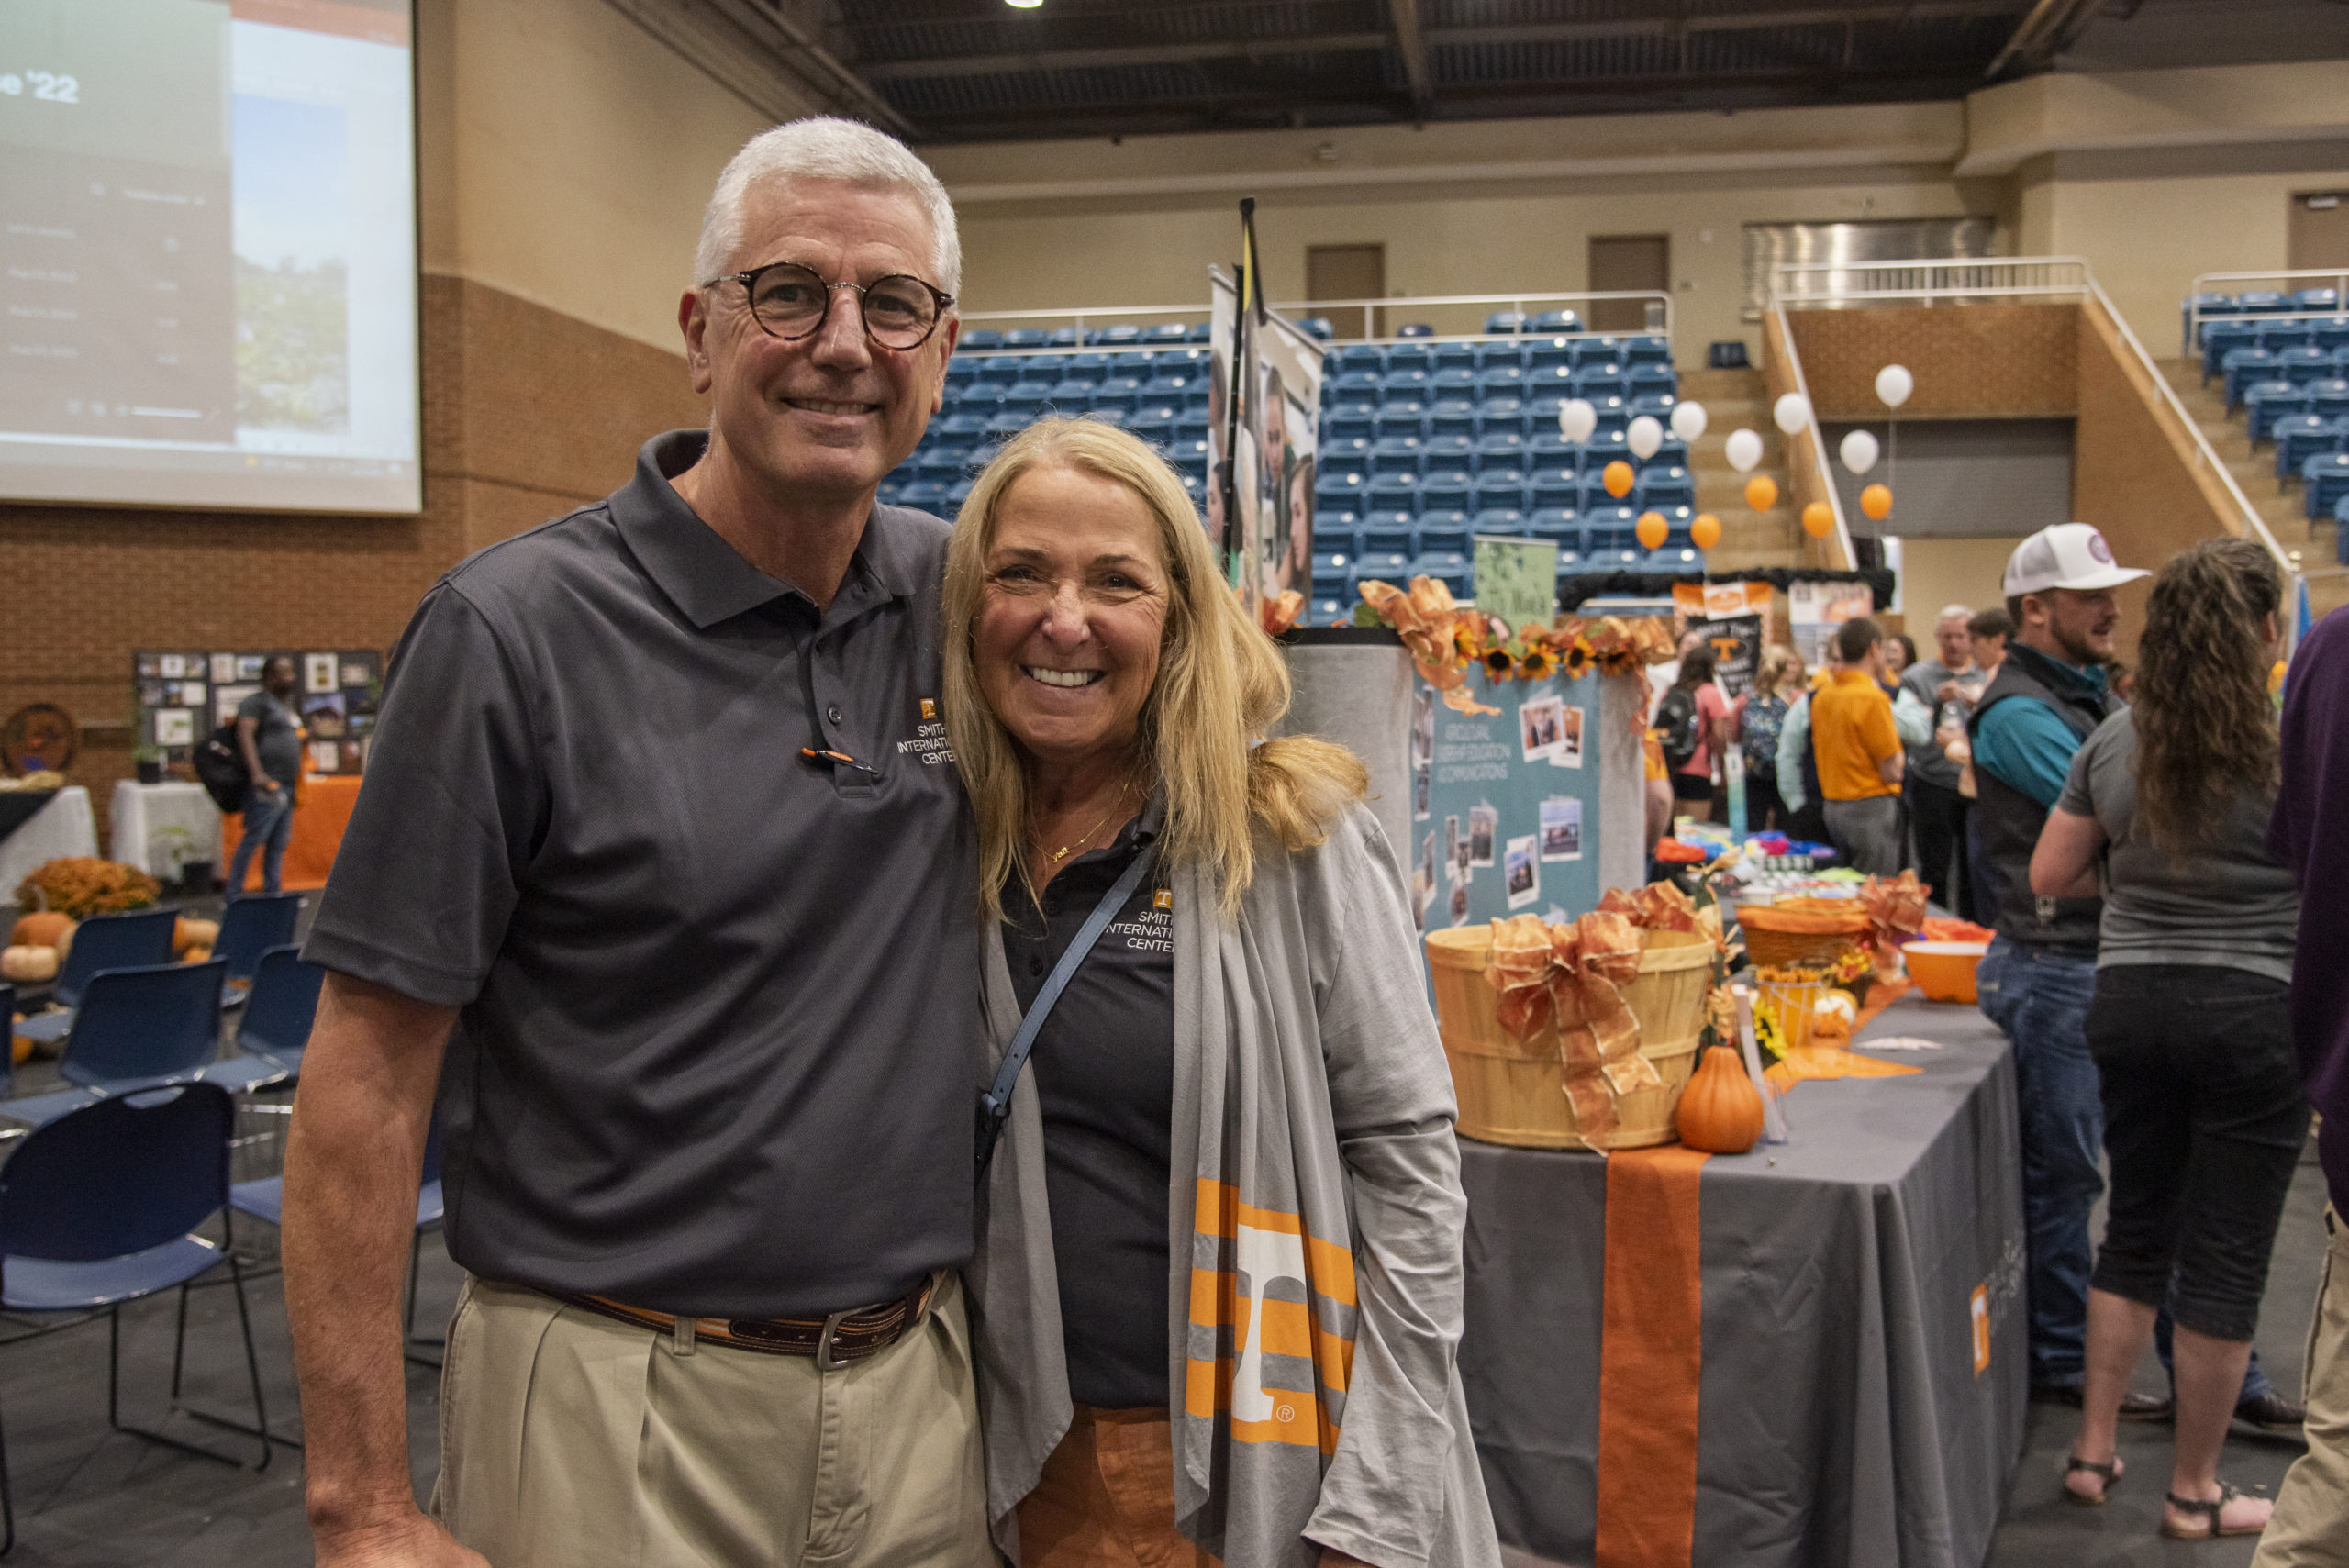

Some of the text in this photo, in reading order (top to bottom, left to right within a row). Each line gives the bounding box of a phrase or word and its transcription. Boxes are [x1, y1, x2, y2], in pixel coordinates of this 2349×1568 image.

[897, 737, 949, 753] INTERNATI
[922, 751, 955, 764] CENTE
[1139, 911, 1173, 925] SMIT
[1106, 923, 1173, 939] NTERNATI
[1127, 938, 1174, 952] CENTE
